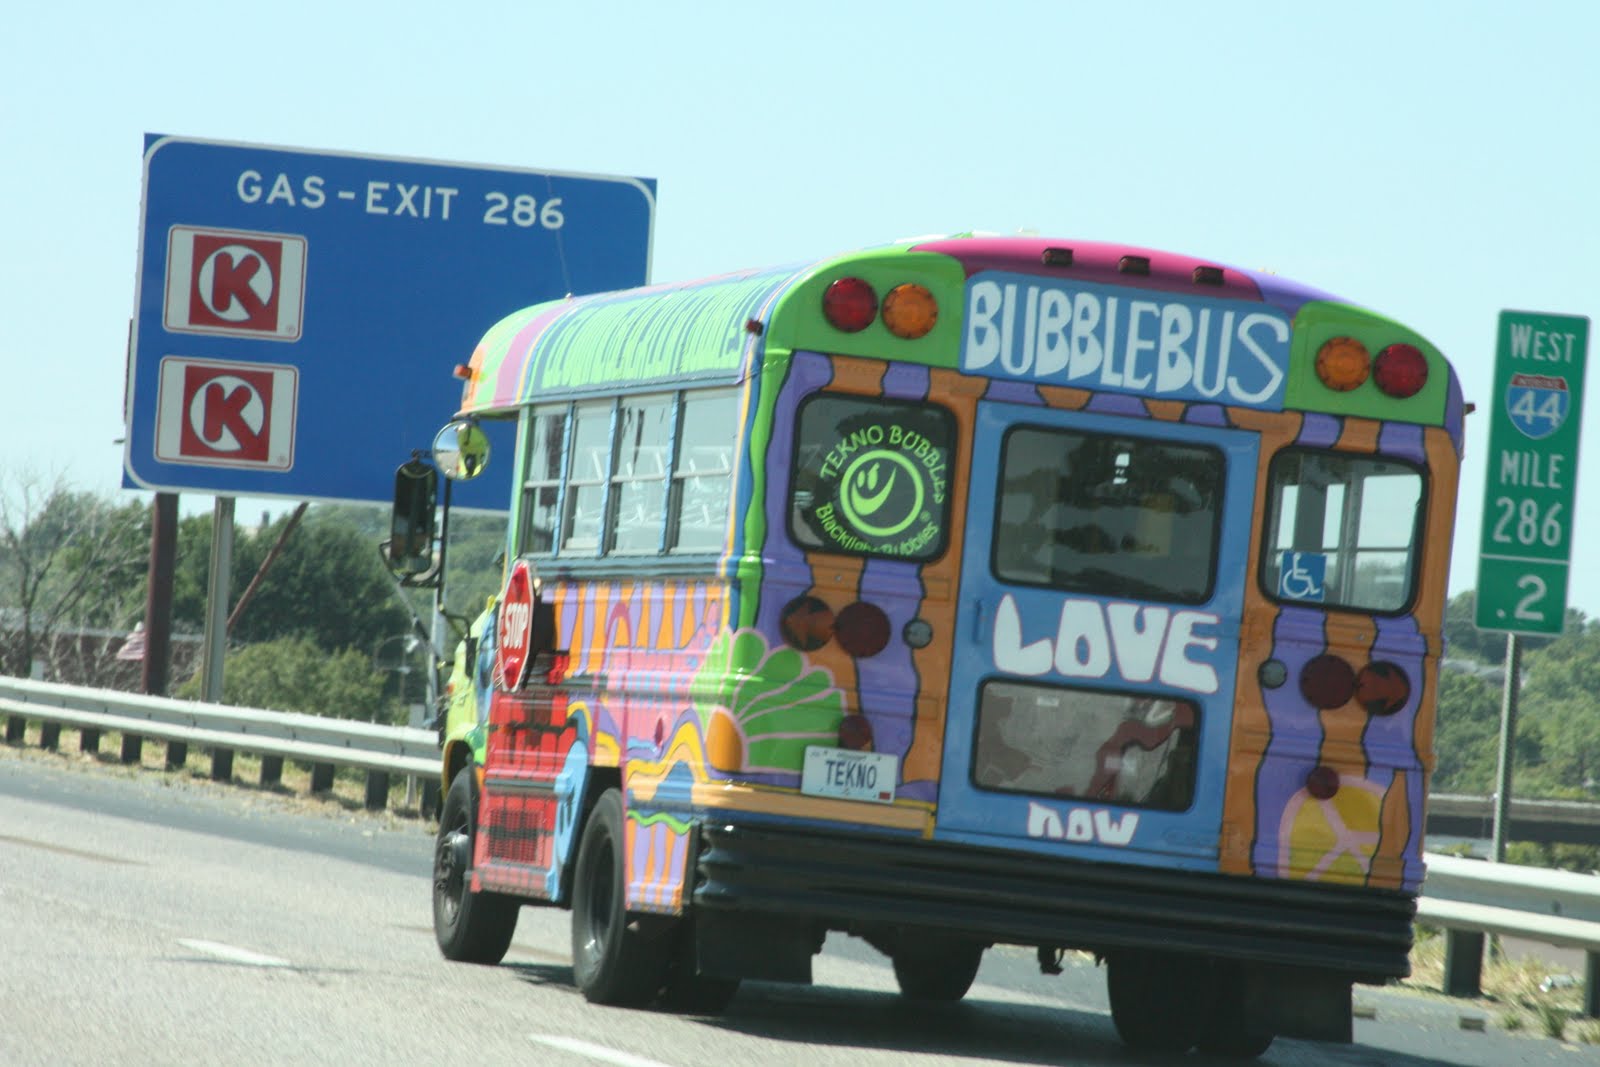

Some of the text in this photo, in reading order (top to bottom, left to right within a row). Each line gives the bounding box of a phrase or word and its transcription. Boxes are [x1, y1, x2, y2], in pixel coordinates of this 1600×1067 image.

[236, 169, 326, 210] GAS
[365, 181, 459, 221] EXIT
[482, 192, 566, 230] 286
[964, 280, 1289, 404] BUBBLEBUS
[1510, 322, 1576, 364] WEST
[1511, 389, 1562, 429] 44
[820, 425, 946, 504] TEKNO BUBBLES
[1500, 449, 1565, 489] MILE
[1492, 496, 1563, 548] 286
[503, 602, 529, 650] STOP
[993, 593, 1219, 694] LOVE
[825, 760, 878, 789] TEKNO
